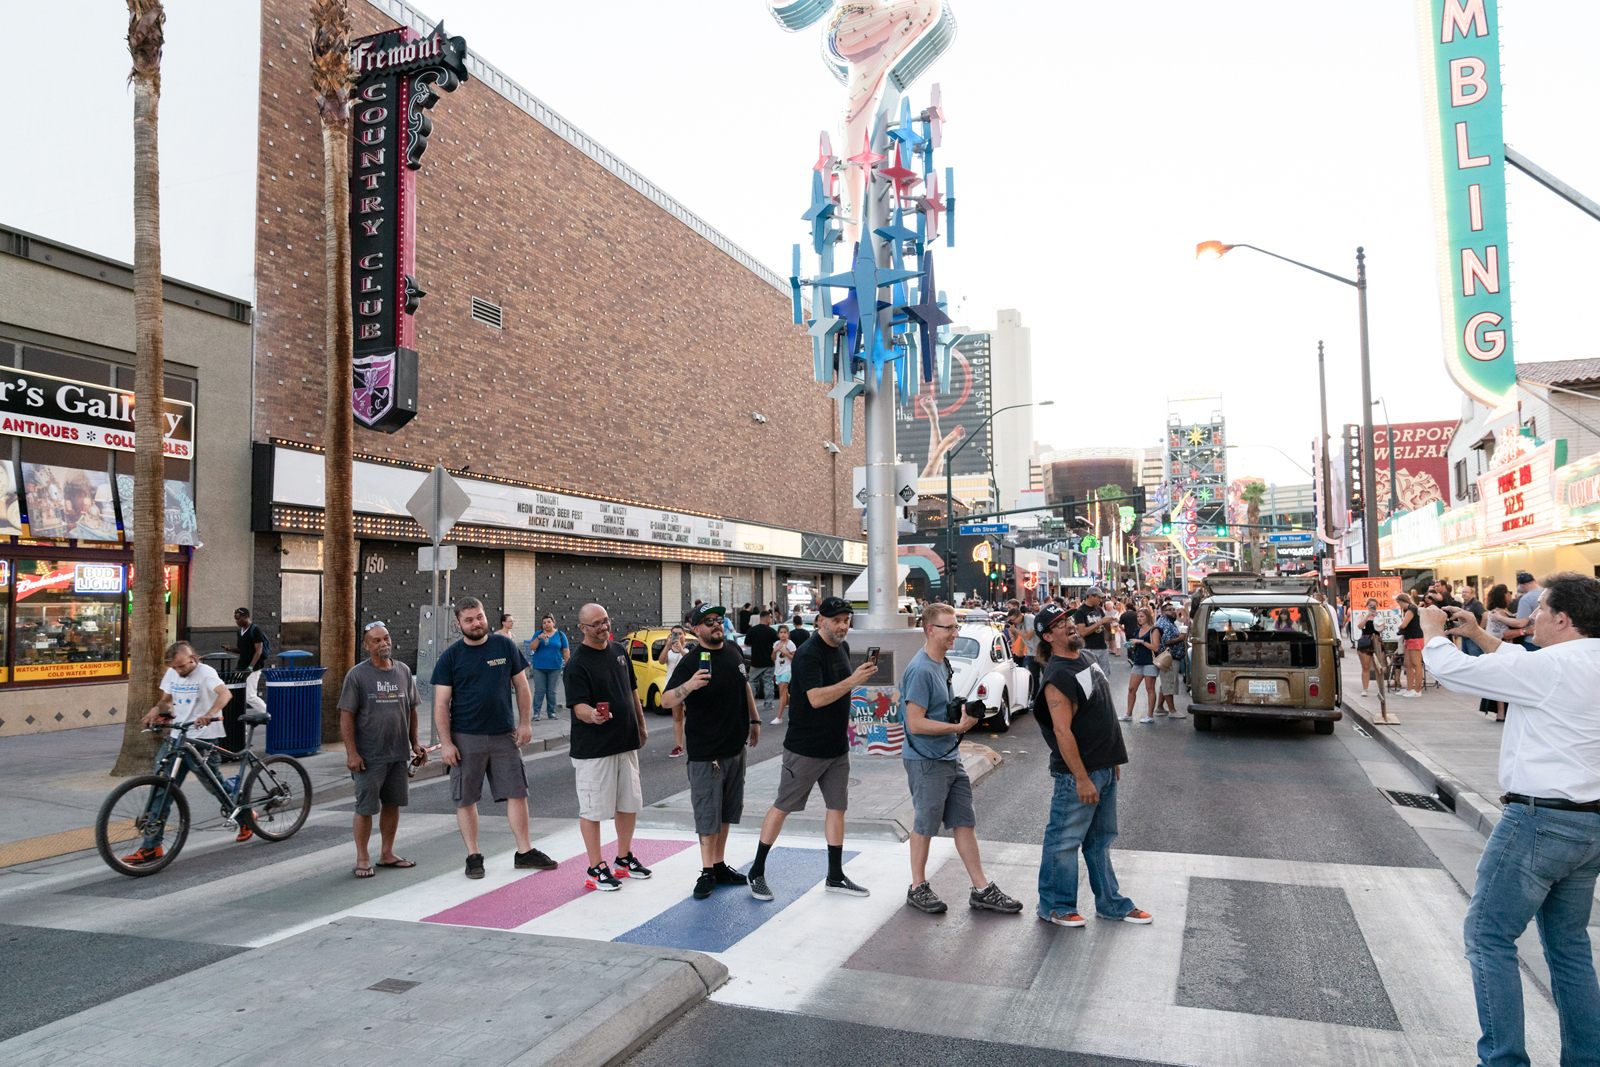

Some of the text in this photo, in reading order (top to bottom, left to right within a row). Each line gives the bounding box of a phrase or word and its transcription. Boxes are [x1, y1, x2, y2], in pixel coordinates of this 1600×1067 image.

[350, 33, 442, 71] Fremont
[358, 82, 387, 236] COUNTRY
[1441, 0, 1506, 361] MBLING
[358, 251, 384, 340] CLUB
[973, 340, 986, 415] LAS VEGAS
[56, 385, 183, 438] Gally
[897, 406, 914, 420] the
[2, 417, 188, 456] ANTIQUES COLLBLES
[536, 493, 559, 506] TONIGHT
[517, 503, 583, 520] NEON CIRCUS BEER FEST
[612, 506, 627, 516] NASTY
[528, 516, 575, 530] MICKEY AVALON
[1185, 497, 1198, 560] VEGAS
[626, 528, 639, 538] KINGS
[365, 556, 385, 573] 150
[83, 566, 115, 579] BUD
[16, 571, 75, 593] Budweiser
[77, 577, 120, 590] LIGHT
[1362, 581, 1389, 589] BEGIN
[856, 705, 873, 717] ALL
[853, 716, 889, 725] NEED IS
[856, 723, 879, 735] LOVE
